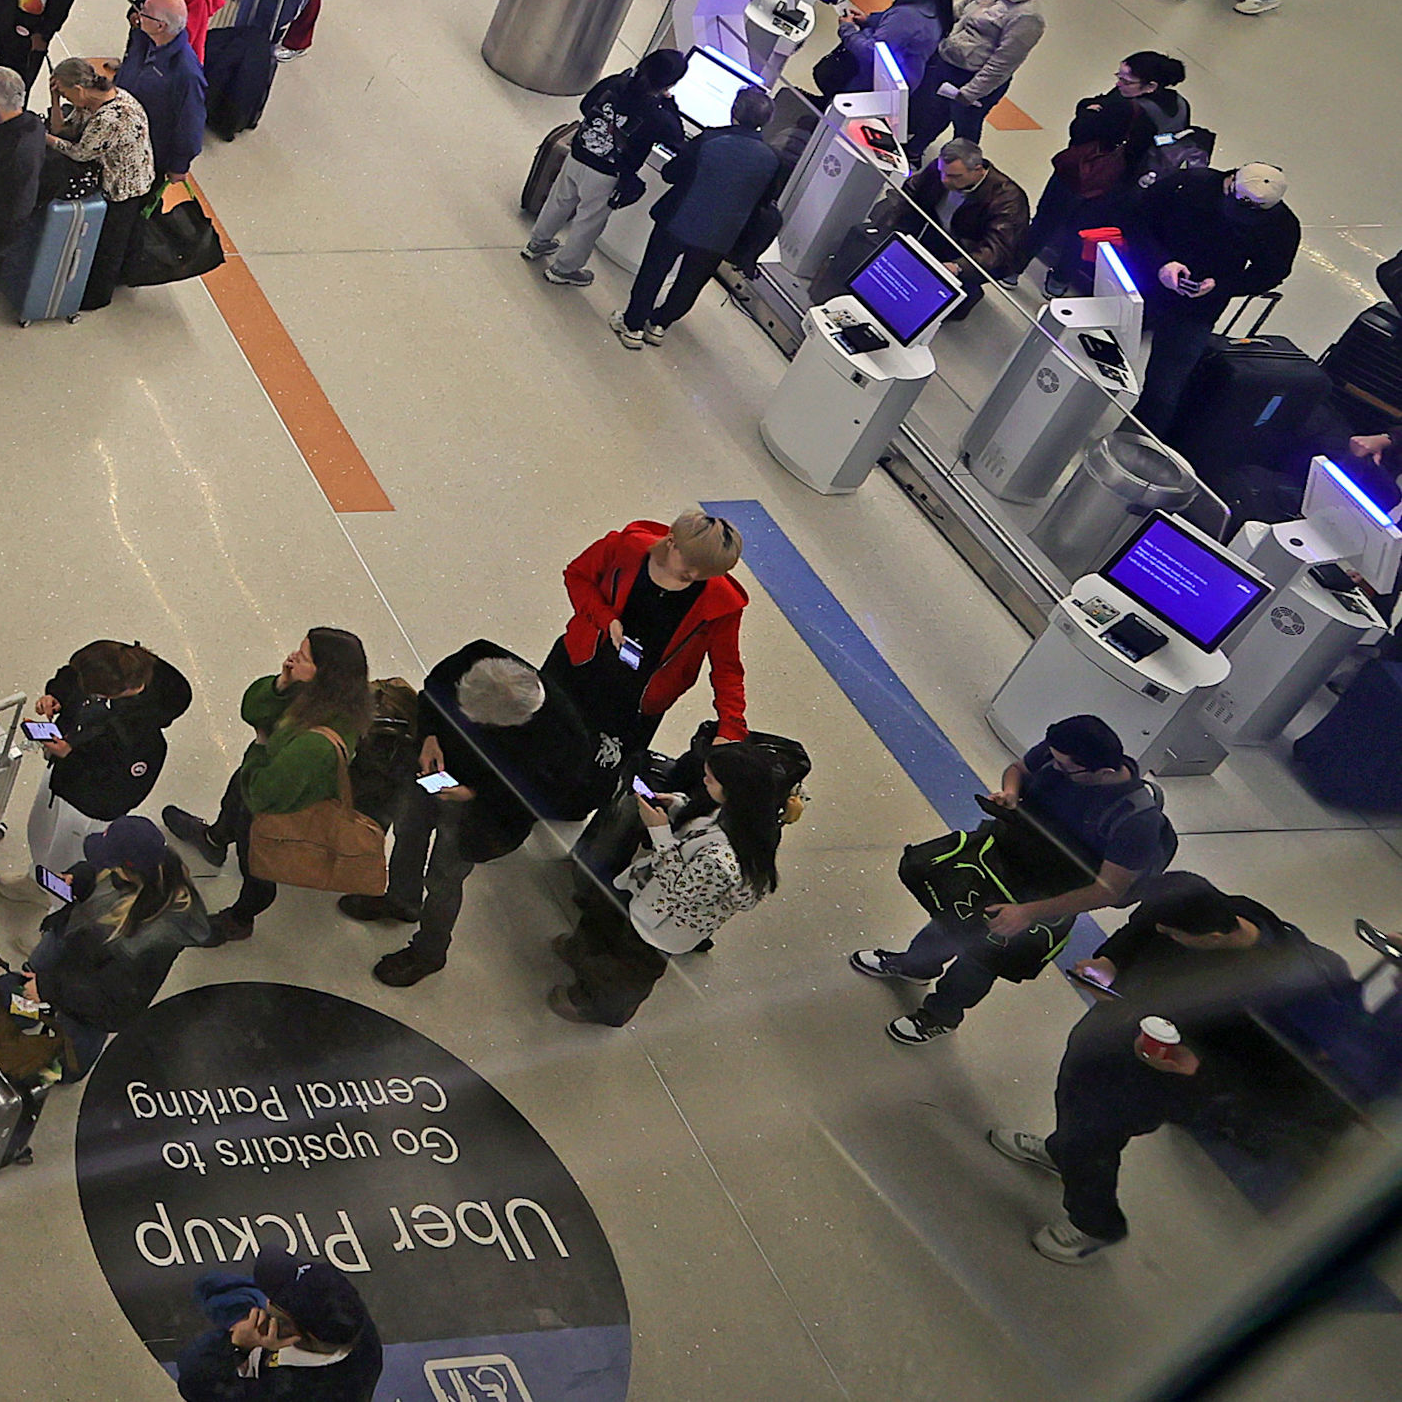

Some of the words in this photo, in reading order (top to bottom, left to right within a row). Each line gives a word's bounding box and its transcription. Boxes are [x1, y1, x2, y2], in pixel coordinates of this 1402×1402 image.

[126, 1080, 289, 1125] Parking
[302, 1076, 448, 1121] Central
[161, 1140, 208, 1175] to
[215, 1122, 381, 1175] upstairs
[392, 1126, 460, 1165] Go
[134, 1202, 372, 1273] Pickup
[391, 1198, 571, 1263] Uber
